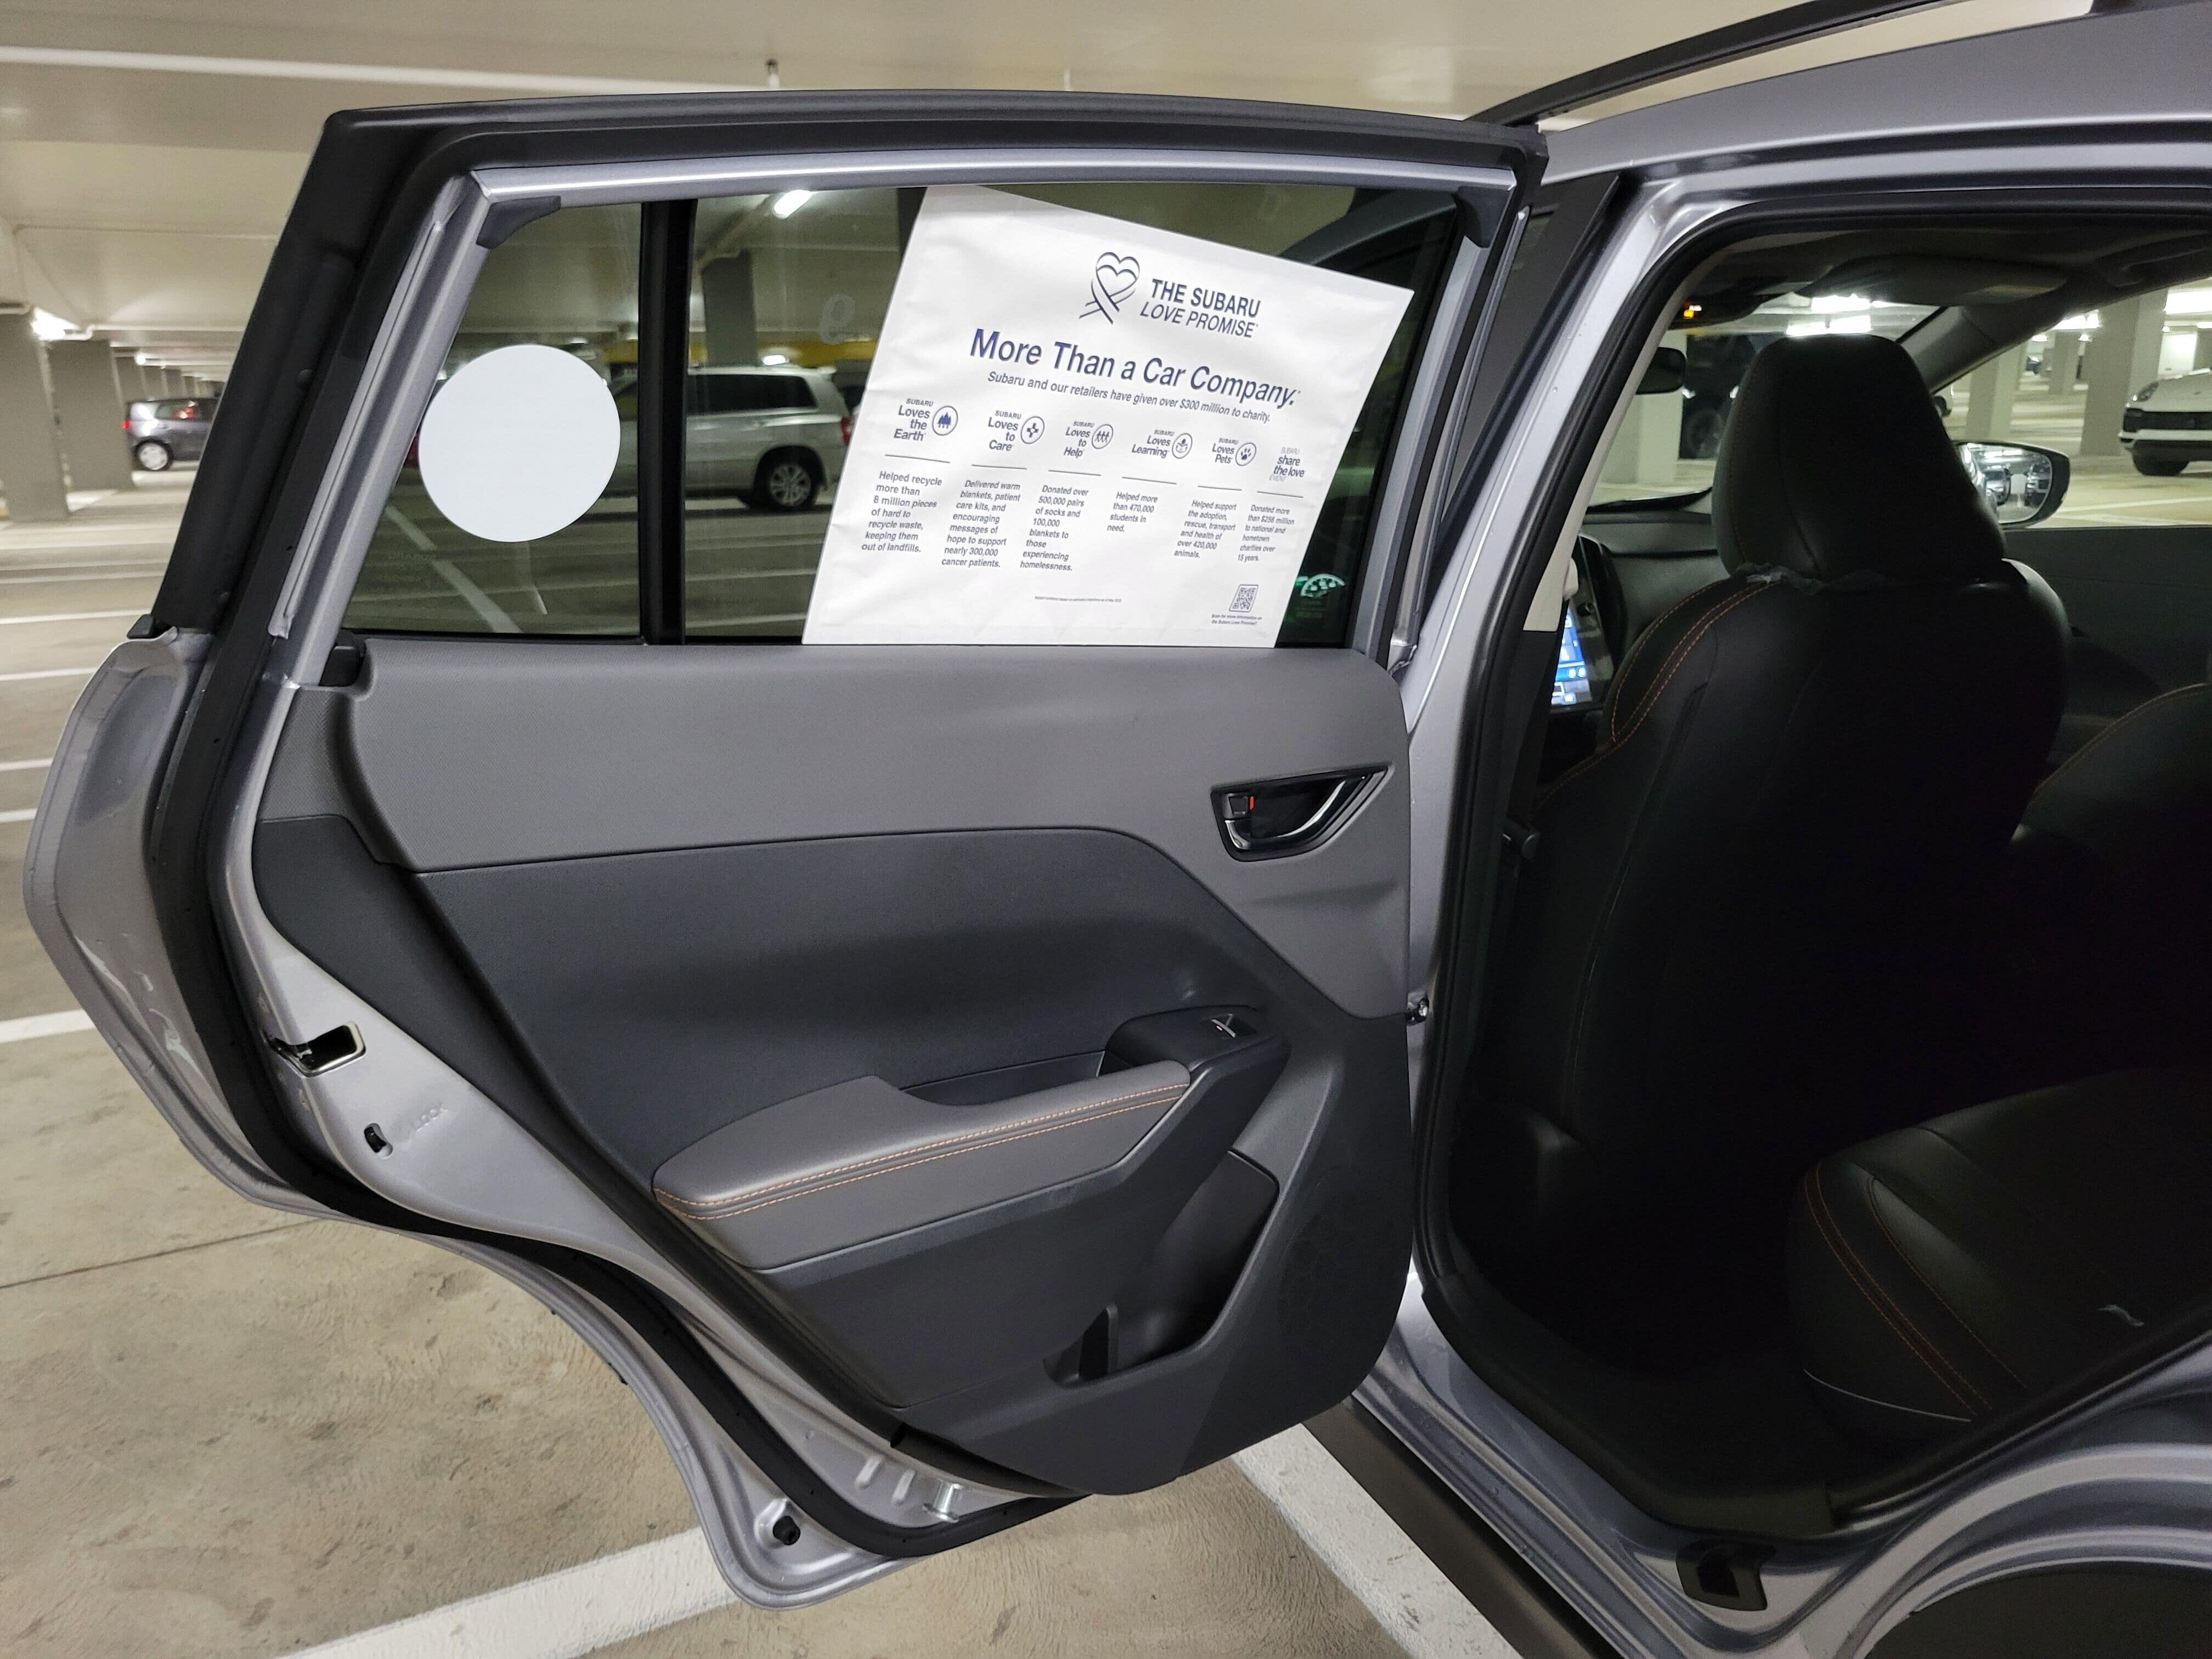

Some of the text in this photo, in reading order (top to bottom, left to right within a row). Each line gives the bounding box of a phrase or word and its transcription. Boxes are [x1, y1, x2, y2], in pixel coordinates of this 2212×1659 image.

[1152, 278, 1261, 319] THE SUBARU
[1139, 301, 1258, 338] LOVE PROMISE
[970, 328, 1042, 365] More
[1054, 341, 1115, 377] Than
[1121, 361, 1136, 380] a
[1143, 357, 1187, 387] Car
[906, 398, 934, 407] SUBARU
[988, 371, 1270, 424] Subaru and our retailers have given over $300 million to charity.
[898, 405, 930, 419] Loves
[995, 410, 1022, 420] SUBARU
[910, 419, 927, 430] the
[988, 416, 1019, 431] Loves
[893, 428, 924, 442] Earth
[1005, 431, 1015, 442] to
[1065, 427, 1091, 438] Loves
[989, 439, 1012, 452] Care
[1078, 438, 1087, 447] to
[1147, 435, 1171, 447] Loves
[1063, 447, 1083, 459] Help
[1212, 443, 1235, 455] Loves
[1215, 454, 1233, 464] Pets
[1277, 454, 1301, 466] share
[1273, 465, 1305, 478] the love
[879, 471, 943, 487] Helped recycle
[964, 479, 1000, 489] Delivered
[876, 484, 921, 496] more than
[1042, 484, 1073, 495] Donated
[960, 490, 1021, 502] blankets, patient
[1038, 495, 1085, 508] 500,000 pairs
[1116, 492, 1141, 502] Helped
[873, 495, 938, 510] 8 million pieces
[974, 501, 990, 512] kits,
[991, 504, 1007, 512] and
[1113, 502, 1155, 513] than 470,000
[1191, 500, 1237, 512] Helped support
[871, 508, 882, 517] of
[882, 509, 902, 518] hard
[1044, 509, 1065, 517] socks
[1066, 510, 1081, 518] and
[1250, 504, 1276, 514] Donated
[952, 514, 1000, 524] encouraging
[1110, 513, 1139, 522] students
[1188, 510, 1227, 521] the adoption,
[868, 520, 923, 531] recycle waste,
[1033, 518, 1060, 527] 100,000
[1184, 521, 1236, 532] rescue, transport
[1275, 517, 1295, 526] million
[949, 524, 998, 535] messages of
[1029, 528, 1060, 538] blankets
[1107, 524, 1125, 532] need.
[865, 531, 918, 541] keeping them
[946, 534, 1007, 547] hope to support
[1194, 531, 1214, 539] health
[1242, 534, 1270, 542] hometown
[877, 543, 887, 551] of
[887, 543, 921, 552] landfills.
[1026, 539, 1047, 548] those
[944, 546, 998, 557] nearly 300,000
[1023, 551, 1069, 562] experiencing
[1173, 549, 1200, 558] animals.
[968, 558, 1001, 568] patients.
[1020, 560, 1073, 571] homelessness.
